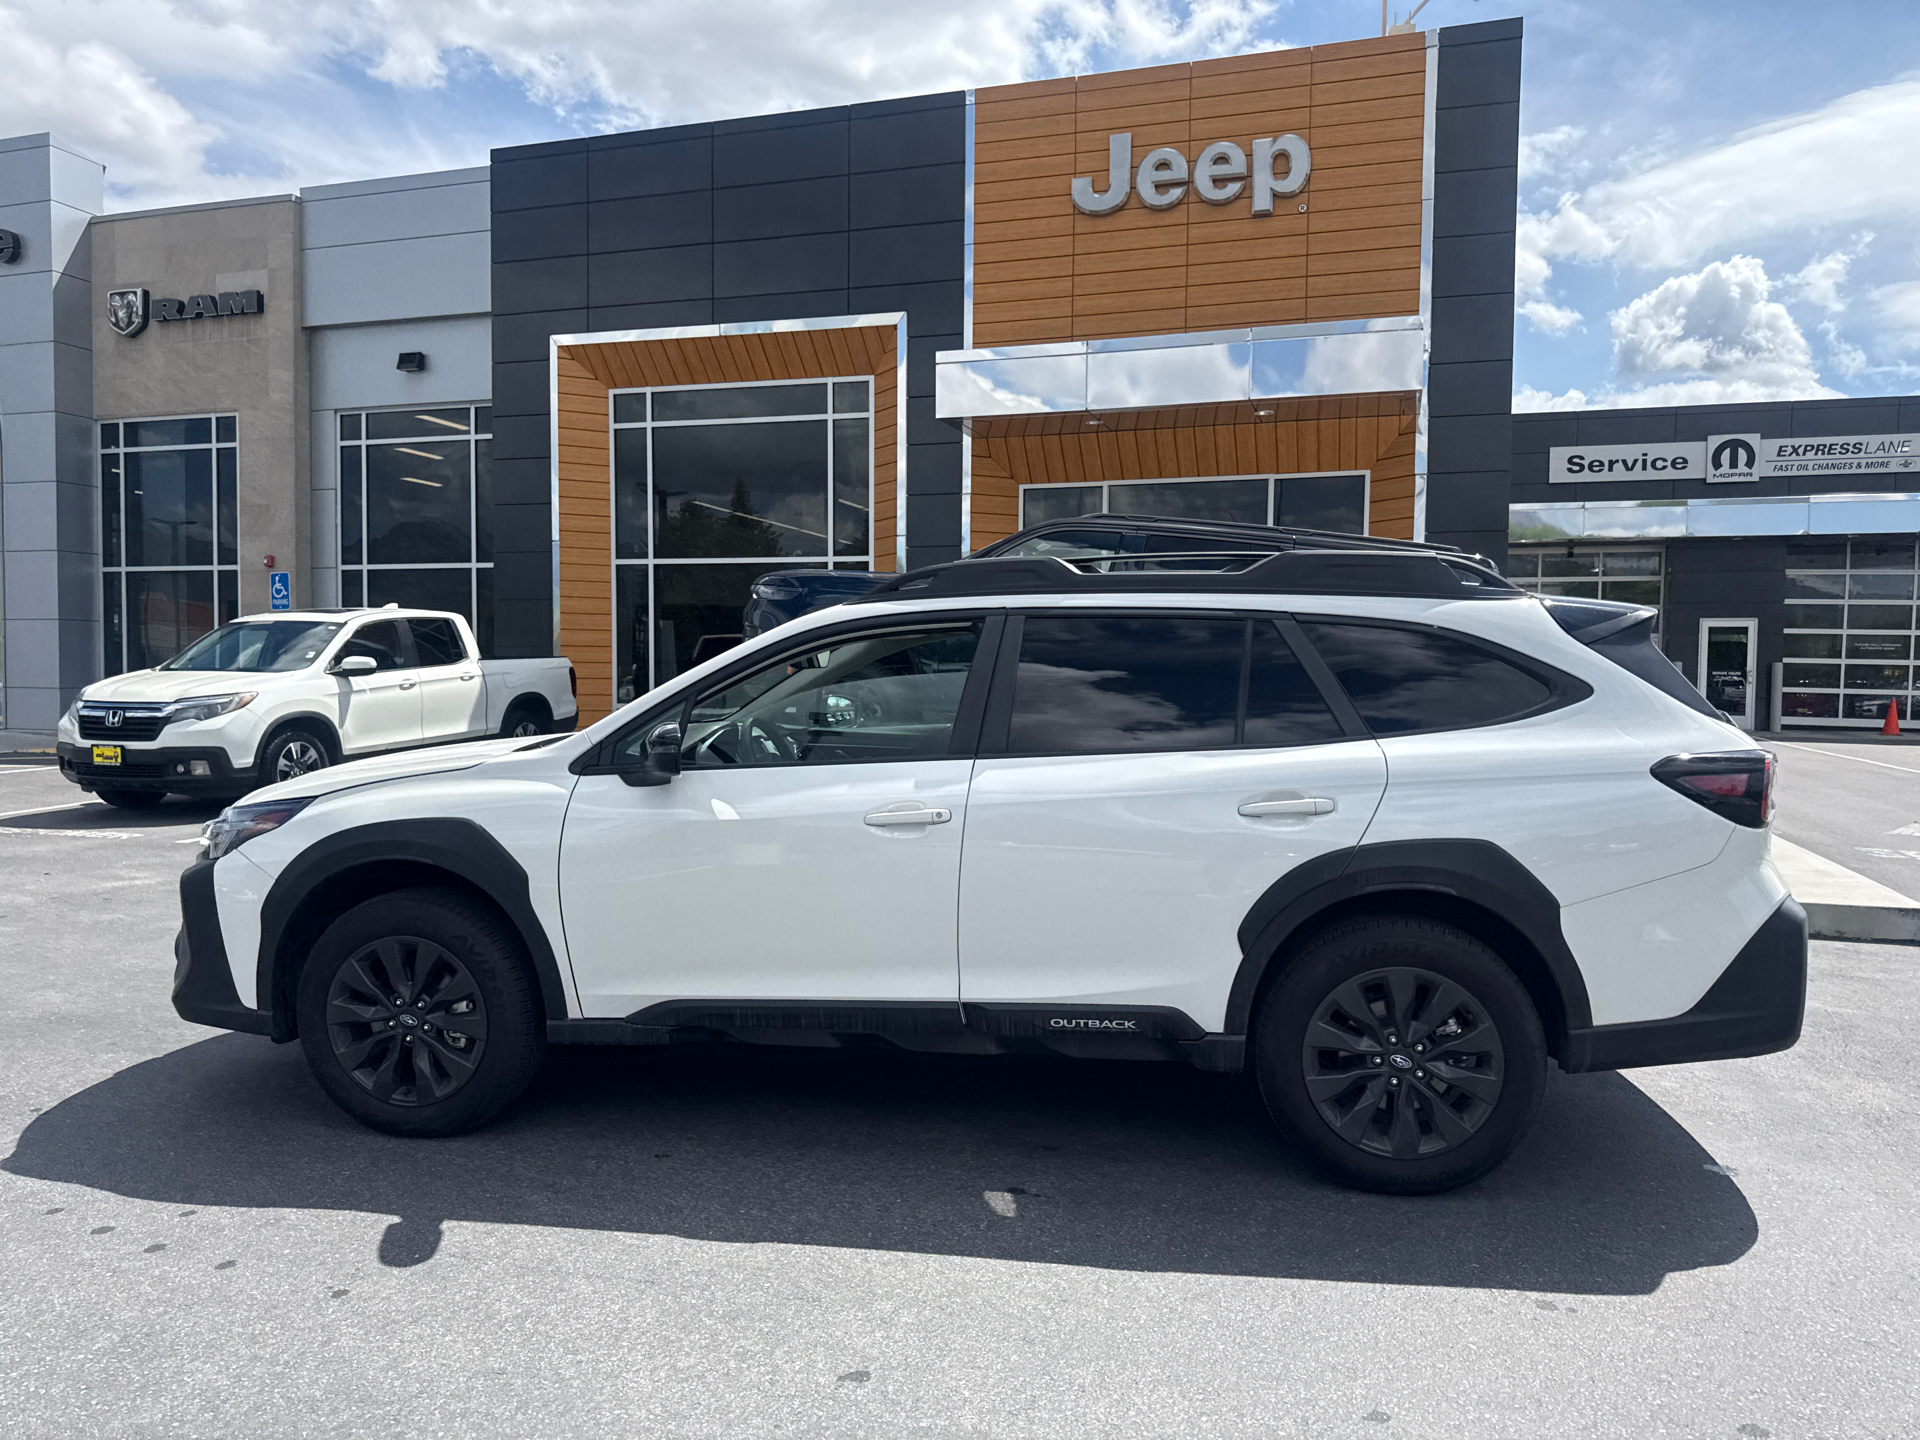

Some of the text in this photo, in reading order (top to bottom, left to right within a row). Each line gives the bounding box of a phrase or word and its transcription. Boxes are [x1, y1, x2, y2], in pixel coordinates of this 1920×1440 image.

[1071, 132, 1312, 216] Jeep
[151, 290, 265, 322] RAM
[1566, 453, 1689, 474] Service
[1773, 463, 1795, 473] FAST
[1796, 463, 1810, 472] OIL
[1811, 461, 1853, 471] CHANGES
[1855, 461, 1862, 470] &
[1864, 460, 1891, 470] MORE
[1050, 1018, 1137, 1029] OUTBACK
